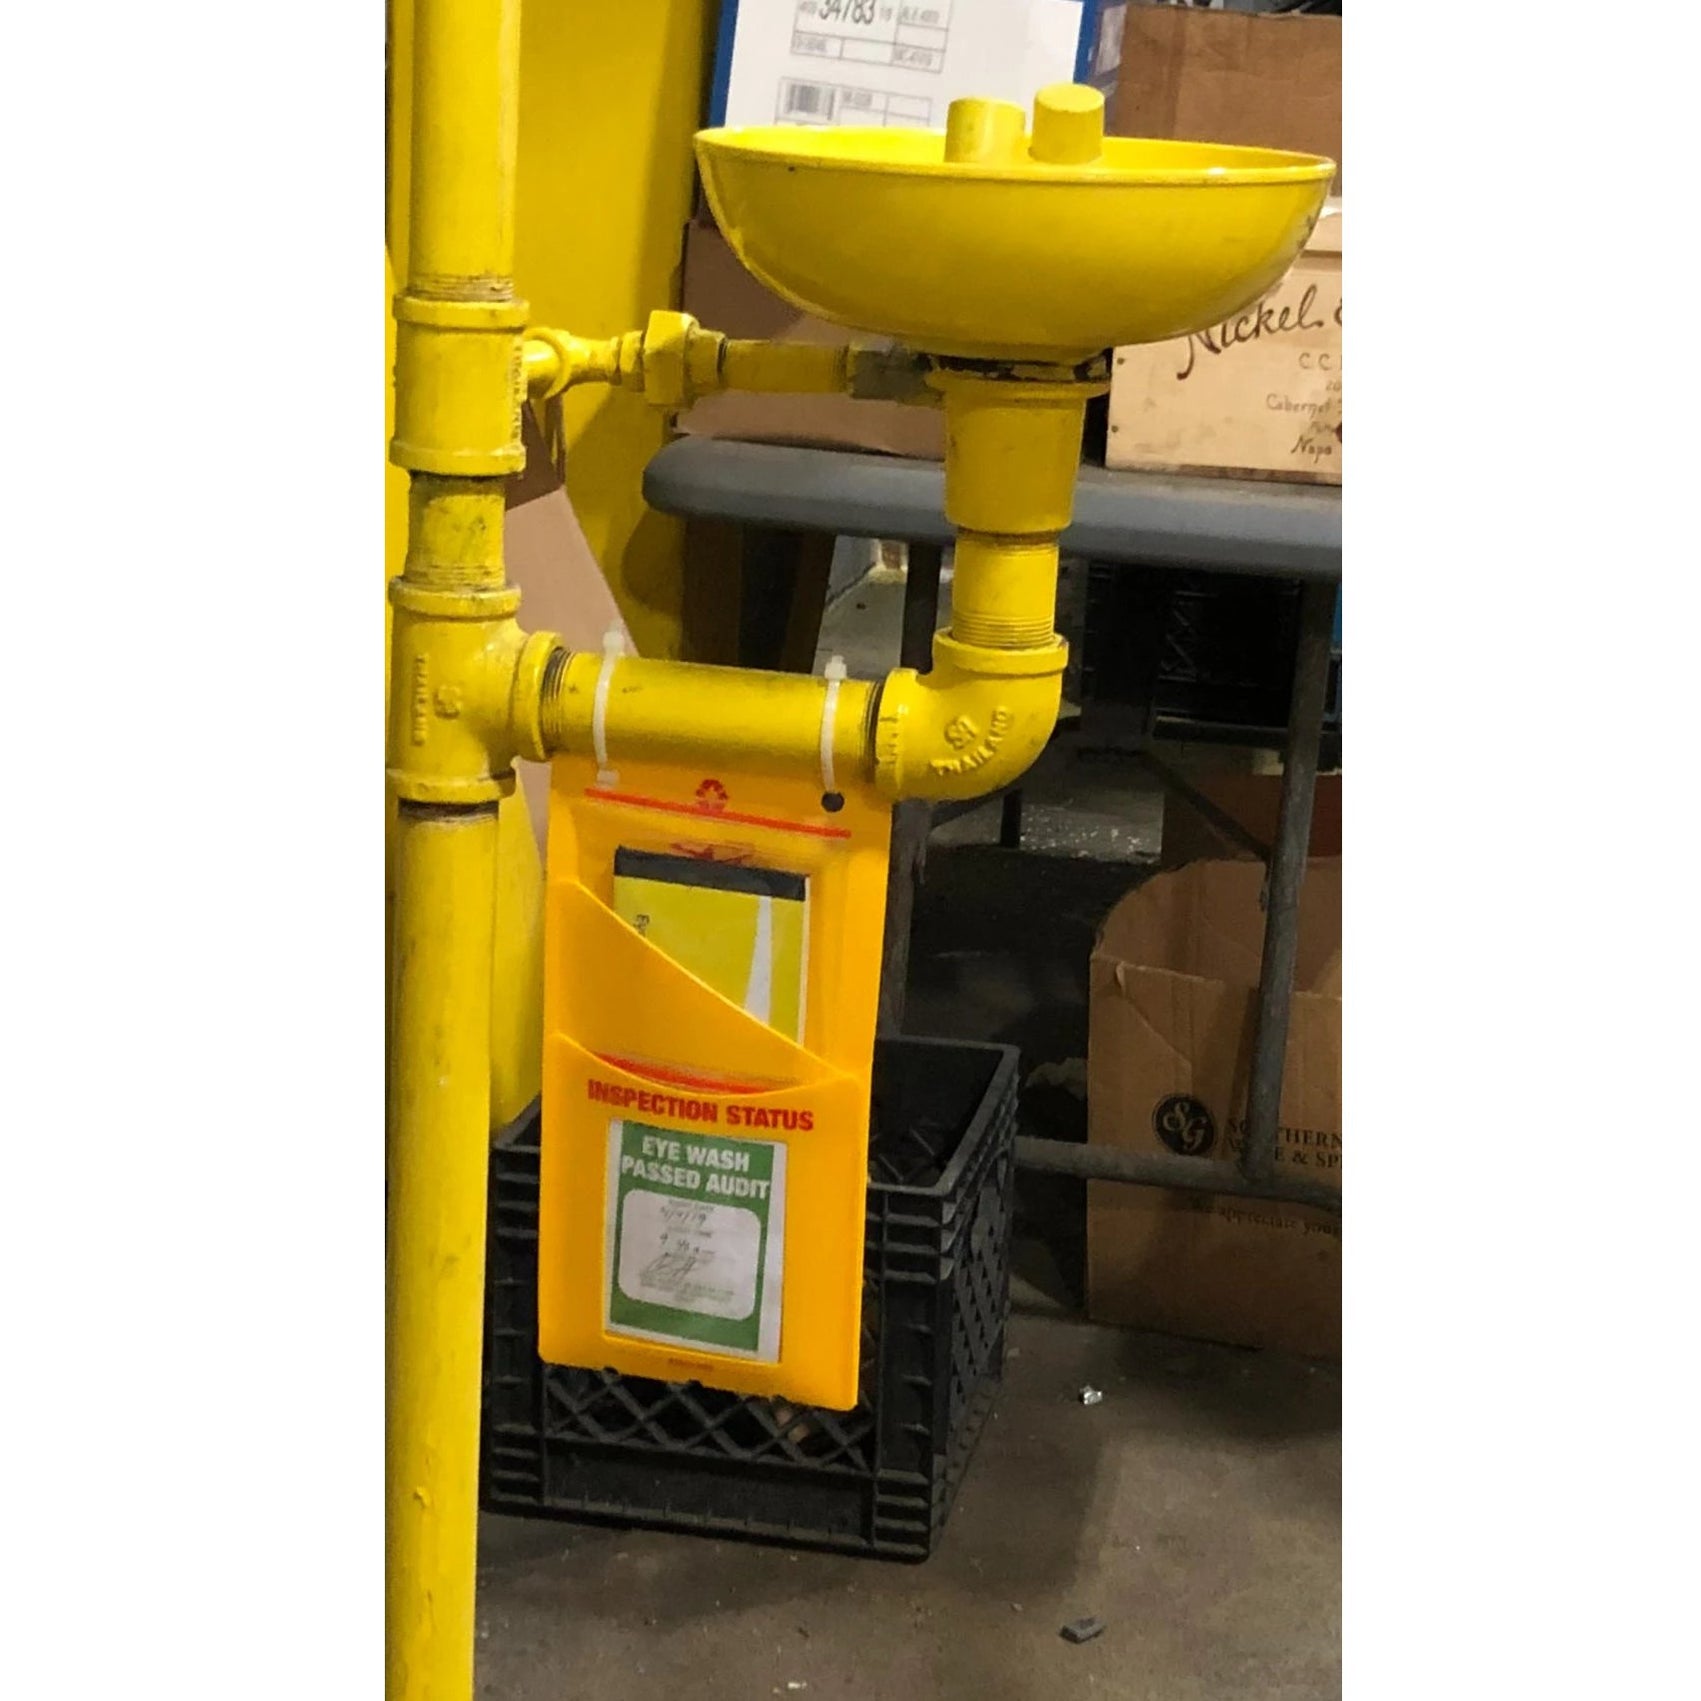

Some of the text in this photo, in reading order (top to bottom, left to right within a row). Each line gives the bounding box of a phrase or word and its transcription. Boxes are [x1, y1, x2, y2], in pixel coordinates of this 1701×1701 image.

[587, 1078, 814, 1131] INSPECTION STATUS
[641, 1135, 750, 1172] EYE WASH
[621, 1154, 770, 1200] PASSED AUDIT
